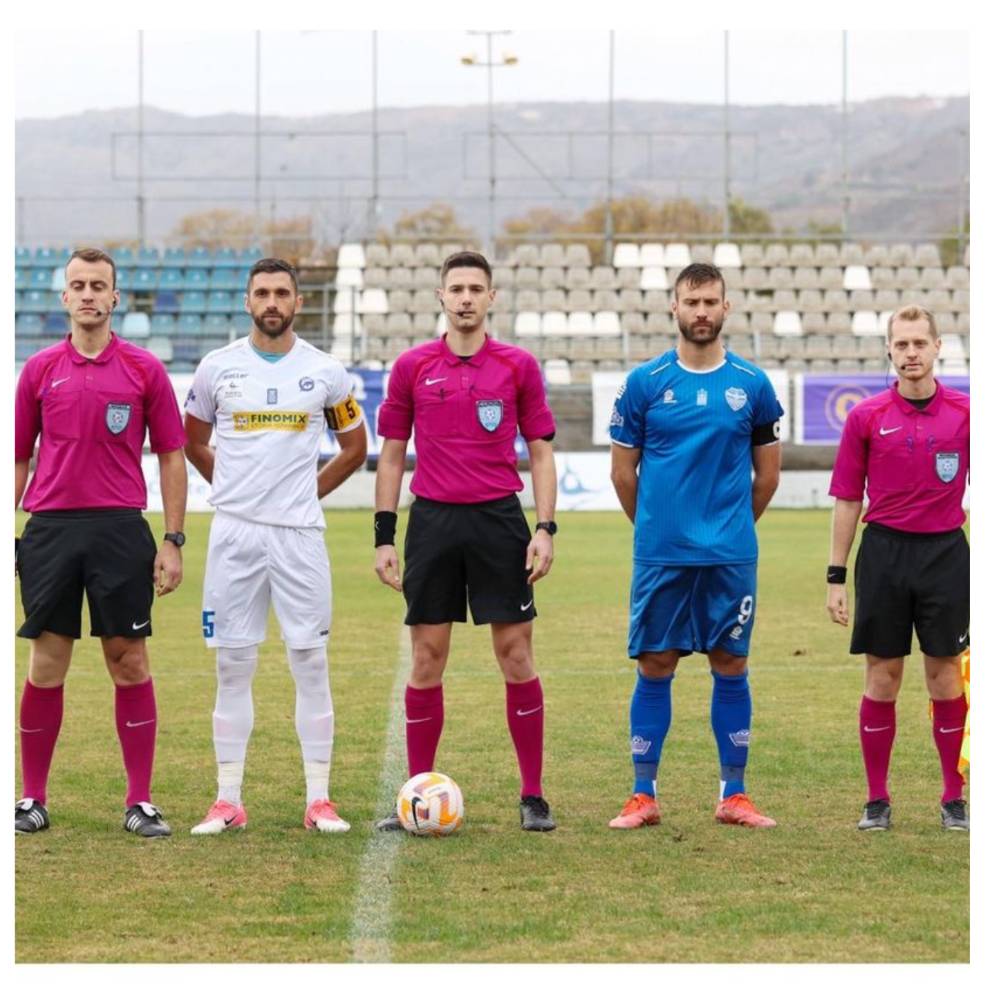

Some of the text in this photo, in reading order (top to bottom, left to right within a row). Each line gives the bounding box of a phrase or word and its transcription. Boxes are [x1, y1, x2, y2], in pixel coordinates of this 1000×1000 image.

[250, 413, 306, 424] FINOMIX
[202, 610, 215, 638] 5
[738, 595, 753, 625] 9
